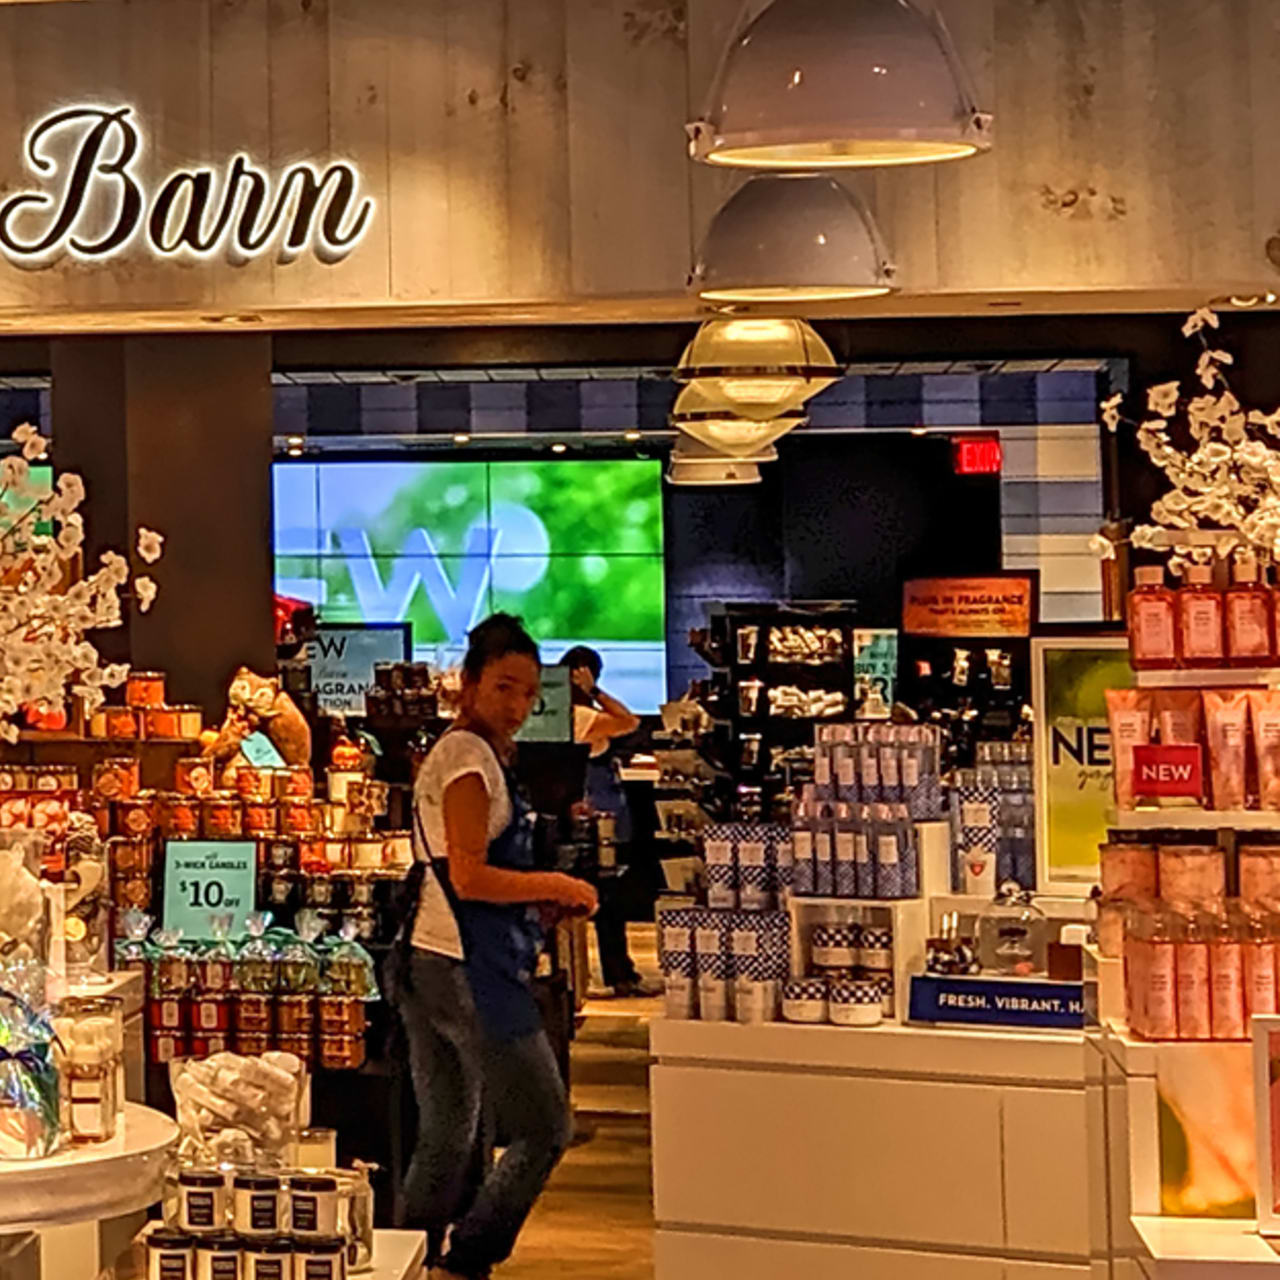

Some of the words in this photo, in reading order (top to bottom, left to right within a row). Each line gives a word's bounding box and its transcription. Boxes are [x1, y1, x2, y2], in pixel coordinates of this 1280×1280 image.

[1142, 763, 1191, 782] NEW
[179, 880, 224, 908] $10
[938, 992, 991, 1009] FRESH.
[995, 995, 1065, 1013] VIBRANT.
